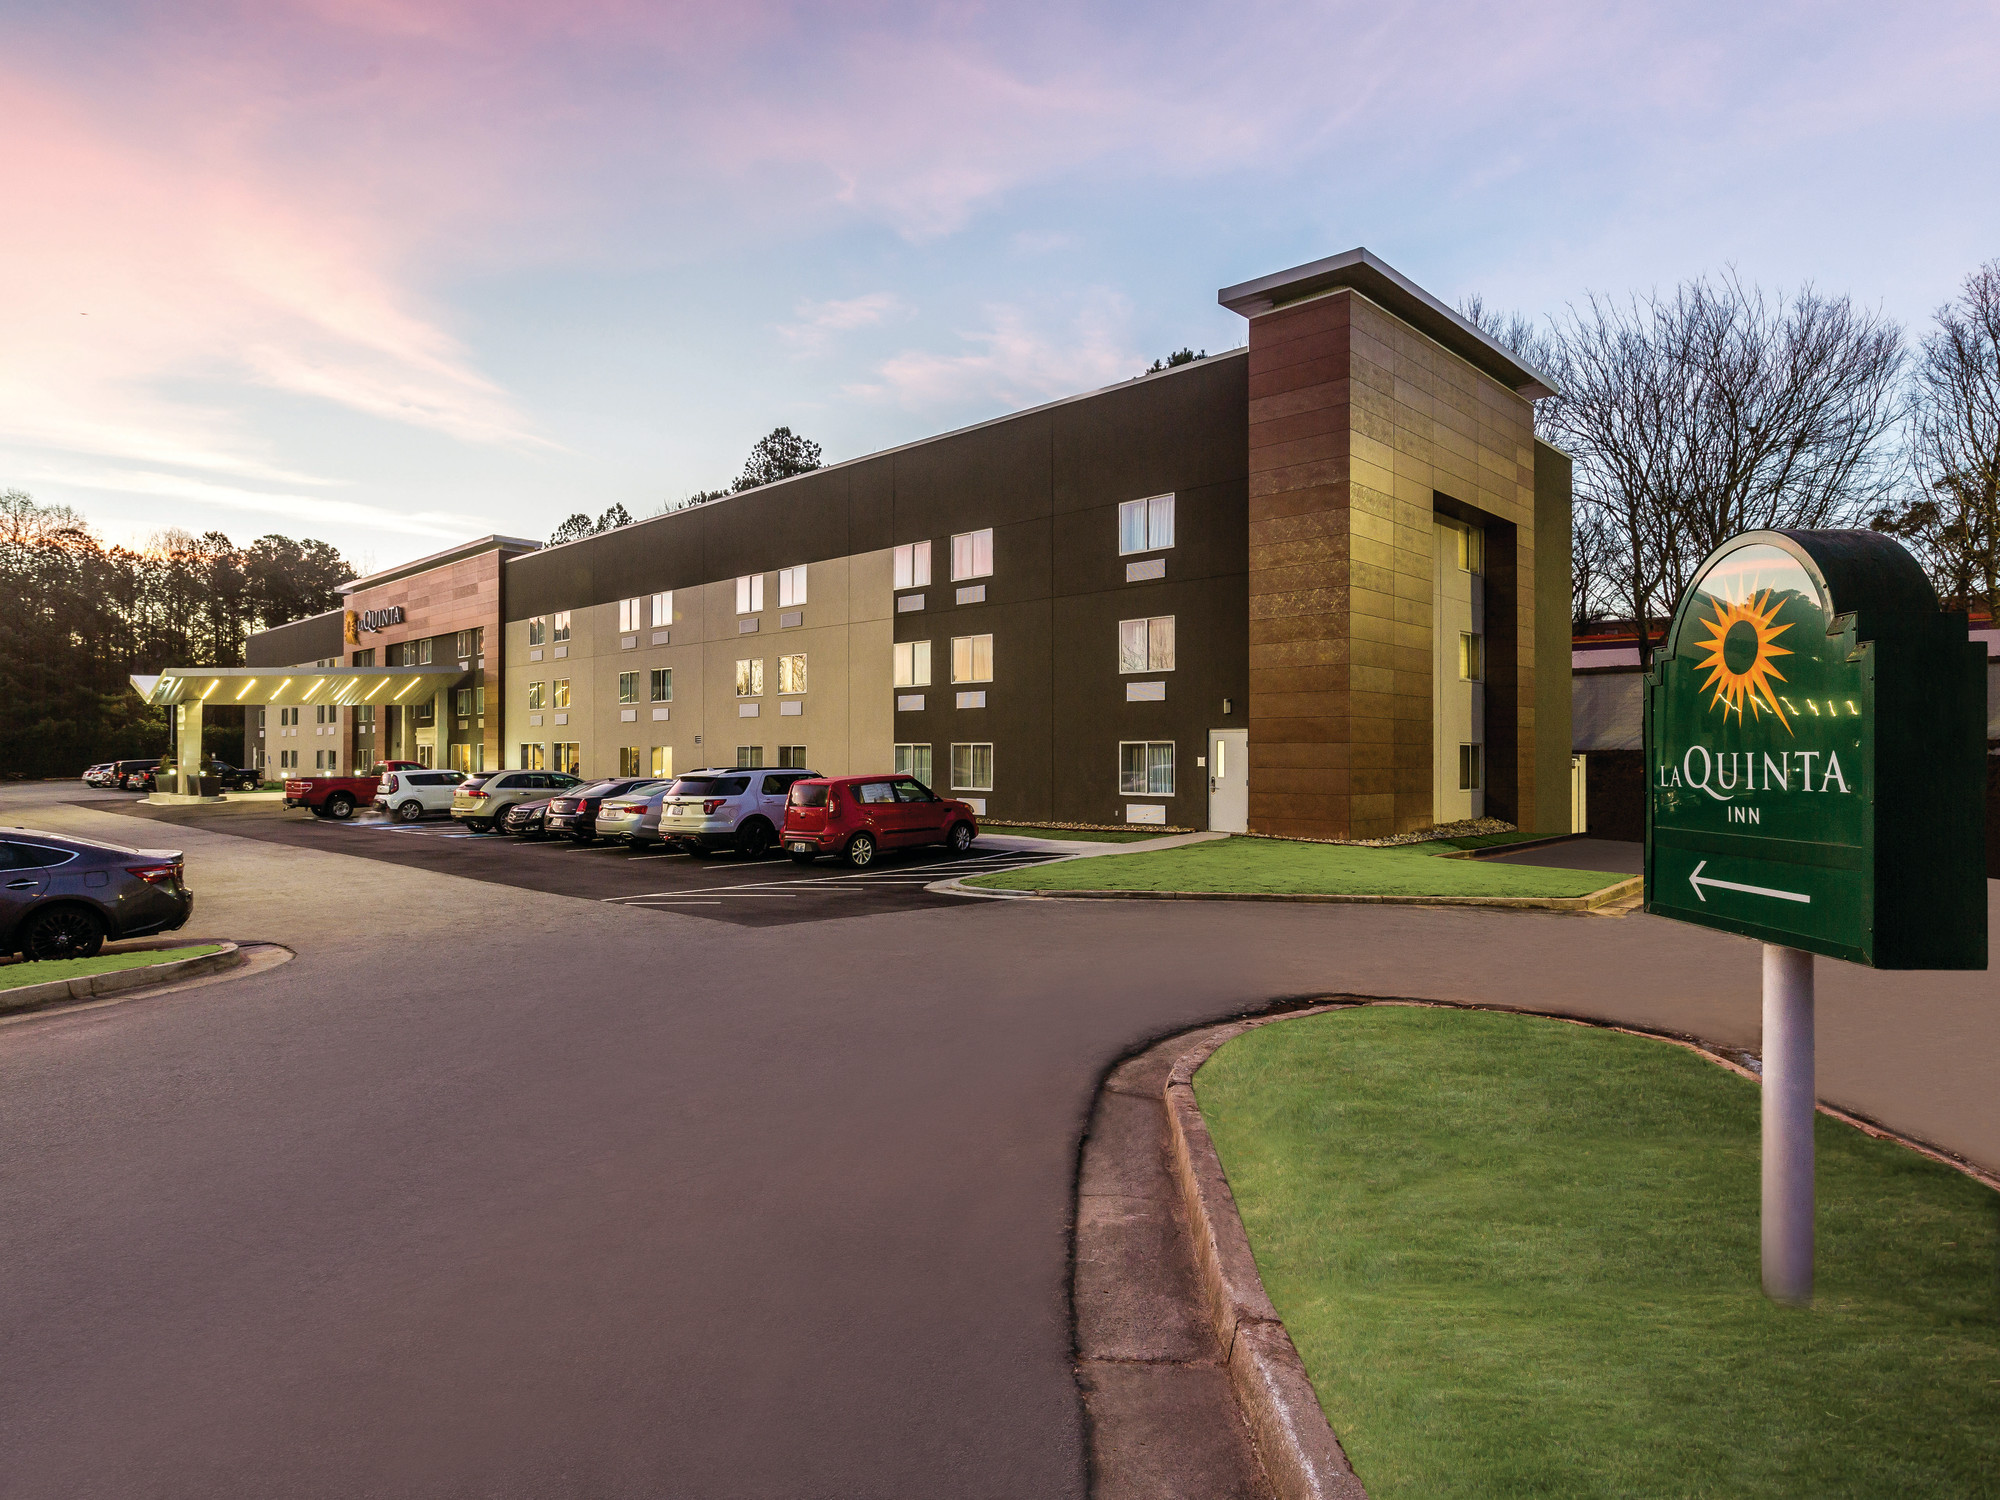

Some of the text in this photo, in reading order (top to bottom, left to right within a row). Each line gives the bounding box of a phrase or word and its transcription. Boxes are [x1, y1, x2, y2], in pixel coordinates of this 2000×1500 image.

[357, 606, 401, 633] LA QUINTA
[1660, 745, 1851, 801] LA QUINTA
[1727, 805, 1760, 825] INN
